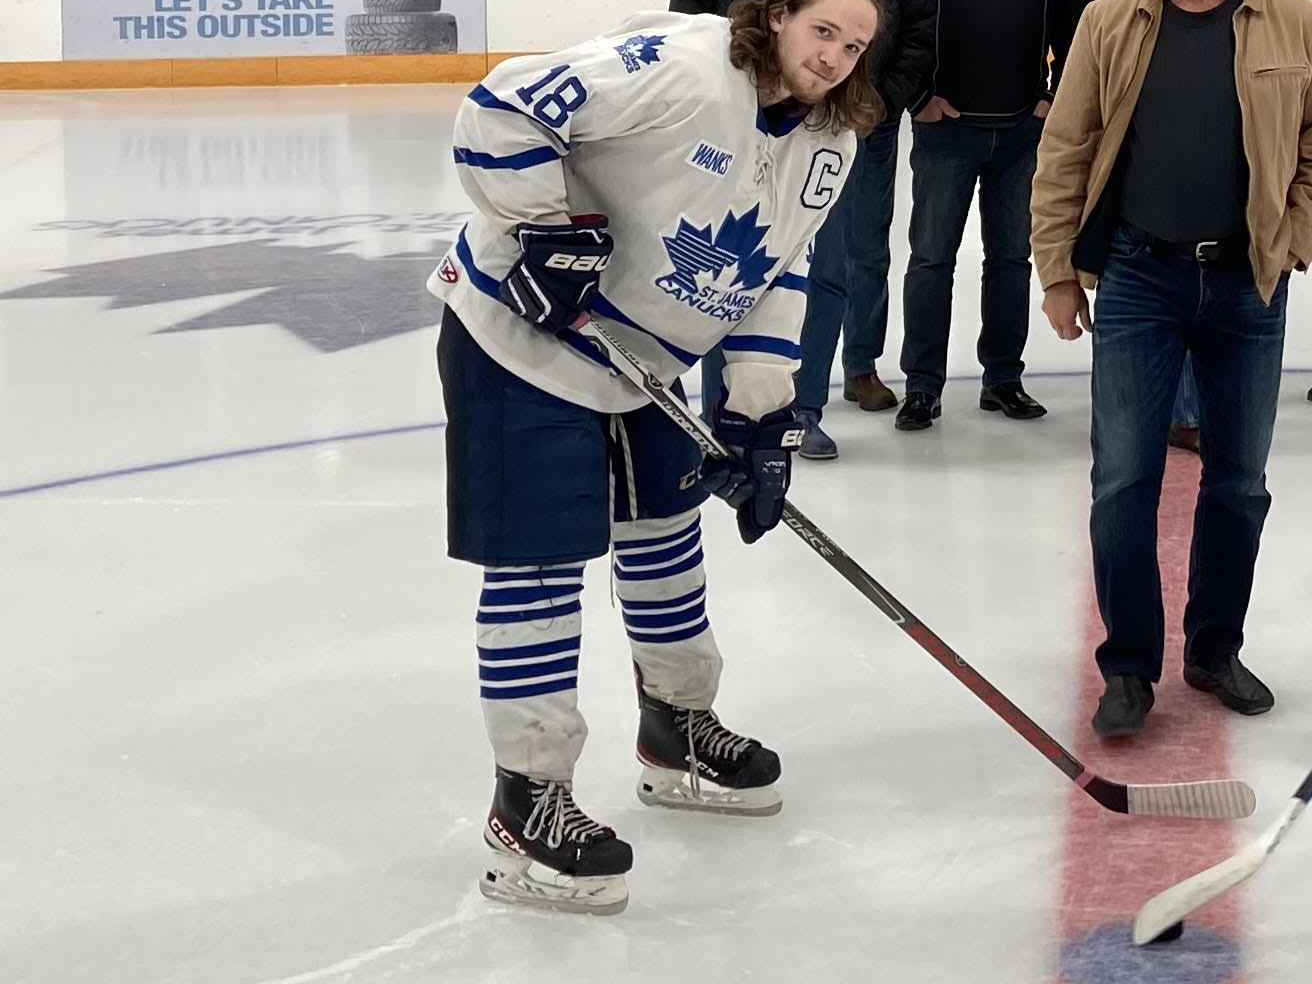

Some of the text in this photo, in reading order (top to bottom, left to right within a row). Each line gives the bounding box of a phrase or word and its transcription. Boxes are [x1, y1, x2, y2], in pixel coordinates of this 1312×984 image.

[112, 12, 335, 40] THIS OUTSIDE
[515, 63, 588, 129] 18
[691, 142, 734, 176] WANKS
[800, 147, 843, 210] C
[655, 274, 745, 322] CANUCKS
[698, 285, 756, 309] ST. JAMES
[488, 817, 526, 856] CCM
